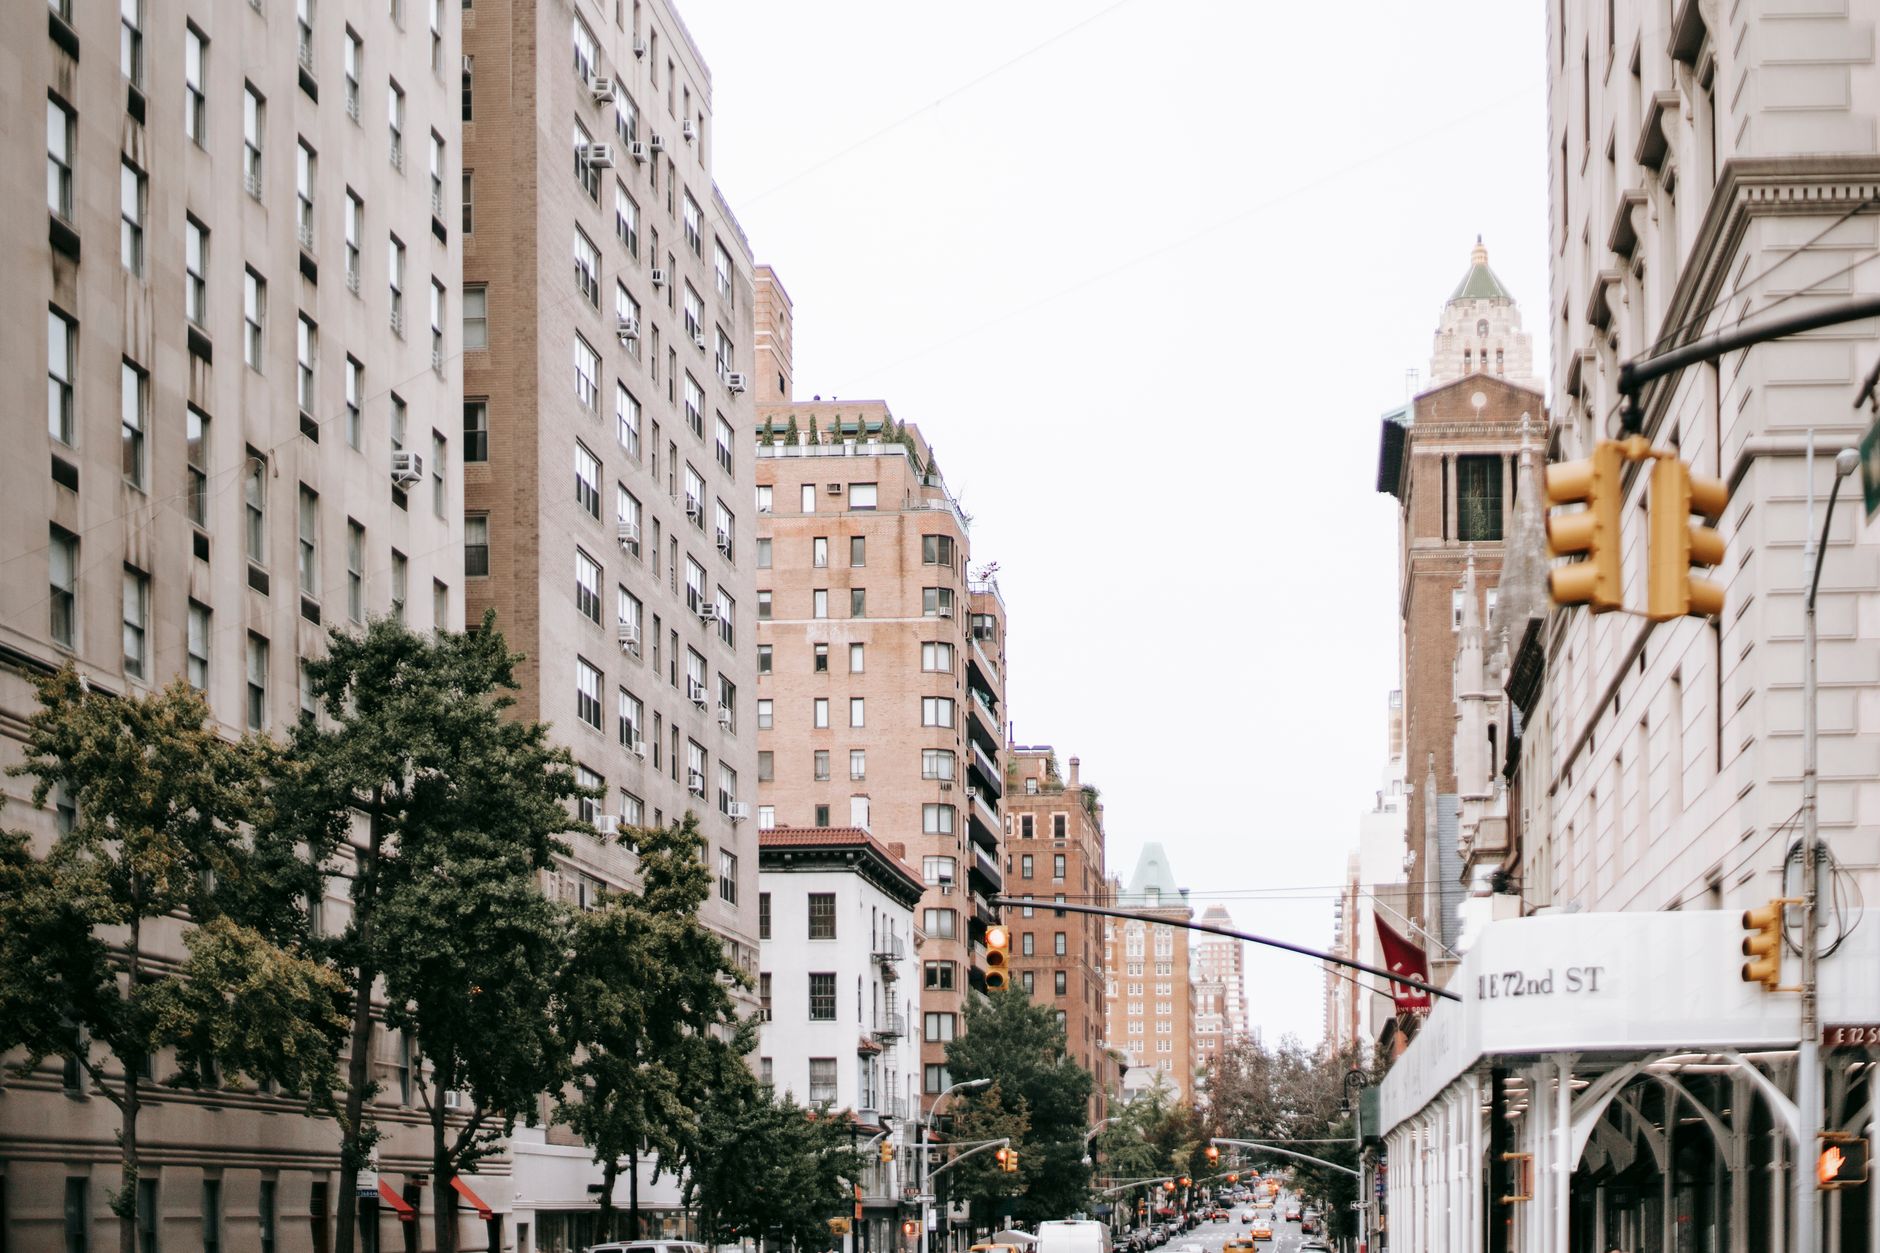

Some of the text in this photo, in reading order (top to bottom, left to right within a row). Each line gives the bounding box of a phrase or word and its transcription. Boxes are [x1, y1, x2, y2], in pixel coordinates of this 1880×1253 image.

[1502, 968, 1554, 997] 72nd
[1565, 966, 1606, 993] ST
[1837, 1027, 1845, 1043] E
[1850, 1027, 1864, 1043] 72
